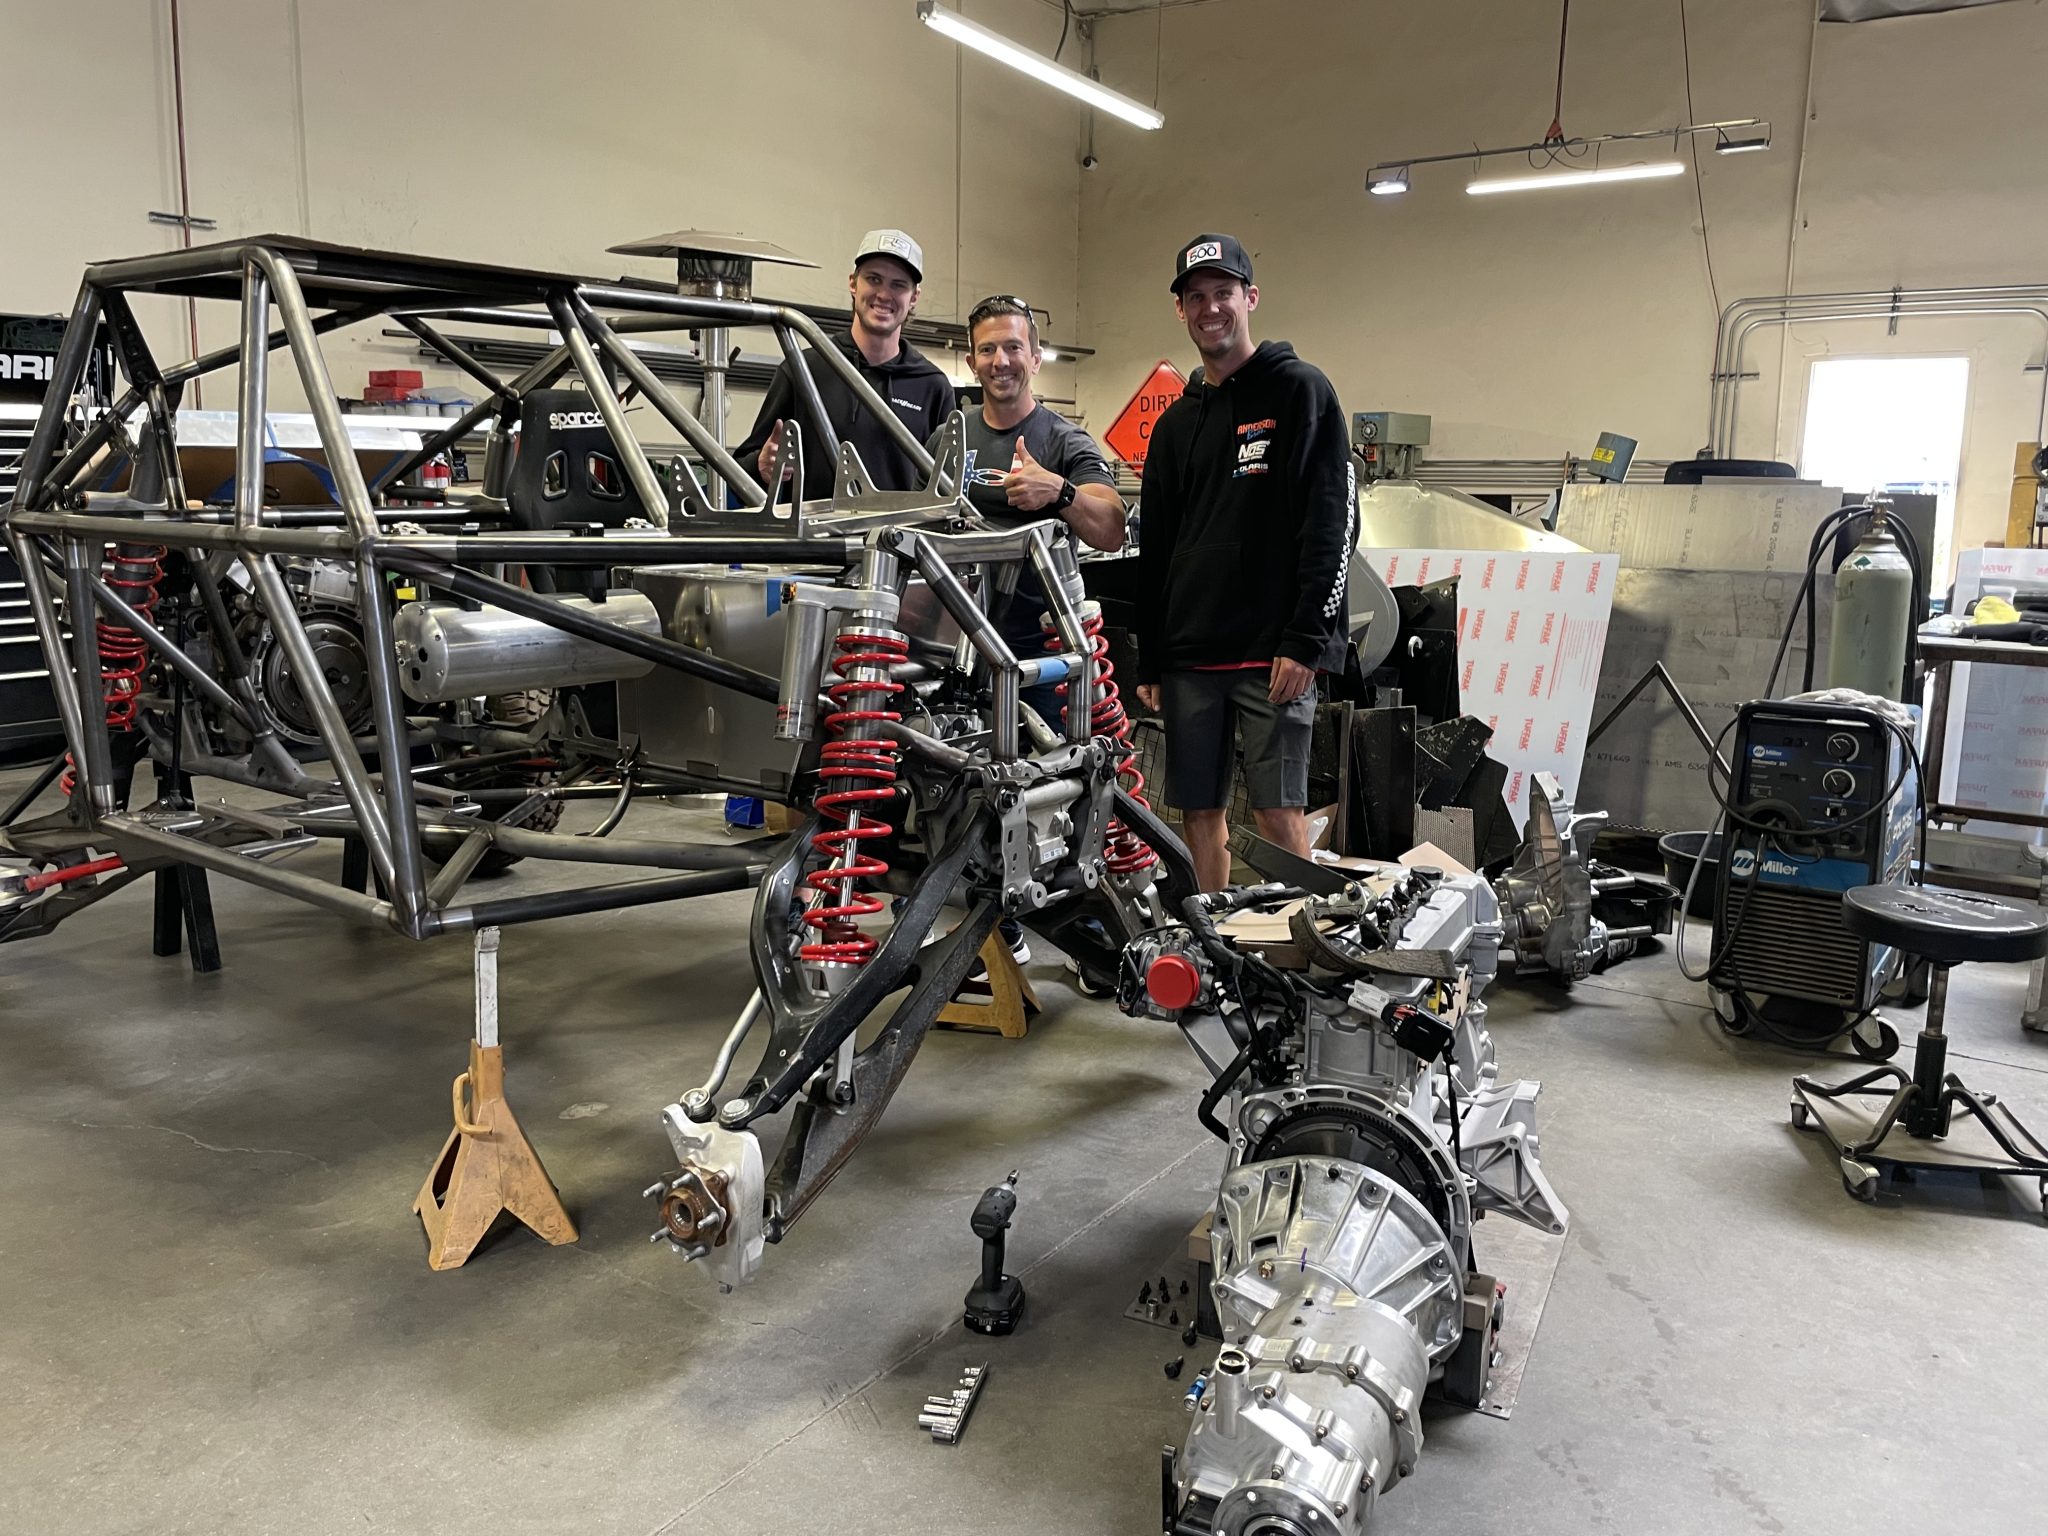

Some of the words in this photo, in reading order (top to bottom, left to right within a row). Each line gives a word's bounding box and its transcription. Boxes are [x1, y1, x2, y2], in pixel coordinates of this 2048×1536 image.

[1190, 247, 1217, 262] 500
[1140, 393, 1184, 413] DIRT
[1482, 558, 1496, 590] TUFFAK
[1516, 559, 1531, 592] TUFFAK
[1551, 560, 1565, 593] TUFFAK
[1586, 561, 1601, 594] TUFFAK
[1472, 608, 1486, 641] TUFFAK
[1505, 610, 1520, 644] TUFFAK
[1540, 612, 1555, 645] TUFFAK
[1461, 660, 1475, 692] TUFFAK
[1495, 662, 1509, 695] TUFFAK
[1529, 664, 1545, 698] TUFFAK
[1519, 718, 1534, 752] TUFFAK
[1555, 721, 1570, 755] TUFFAK
[1508, 771, 1523, 804] TUFFAK
[1760, 860, 1799, 876] Miller
